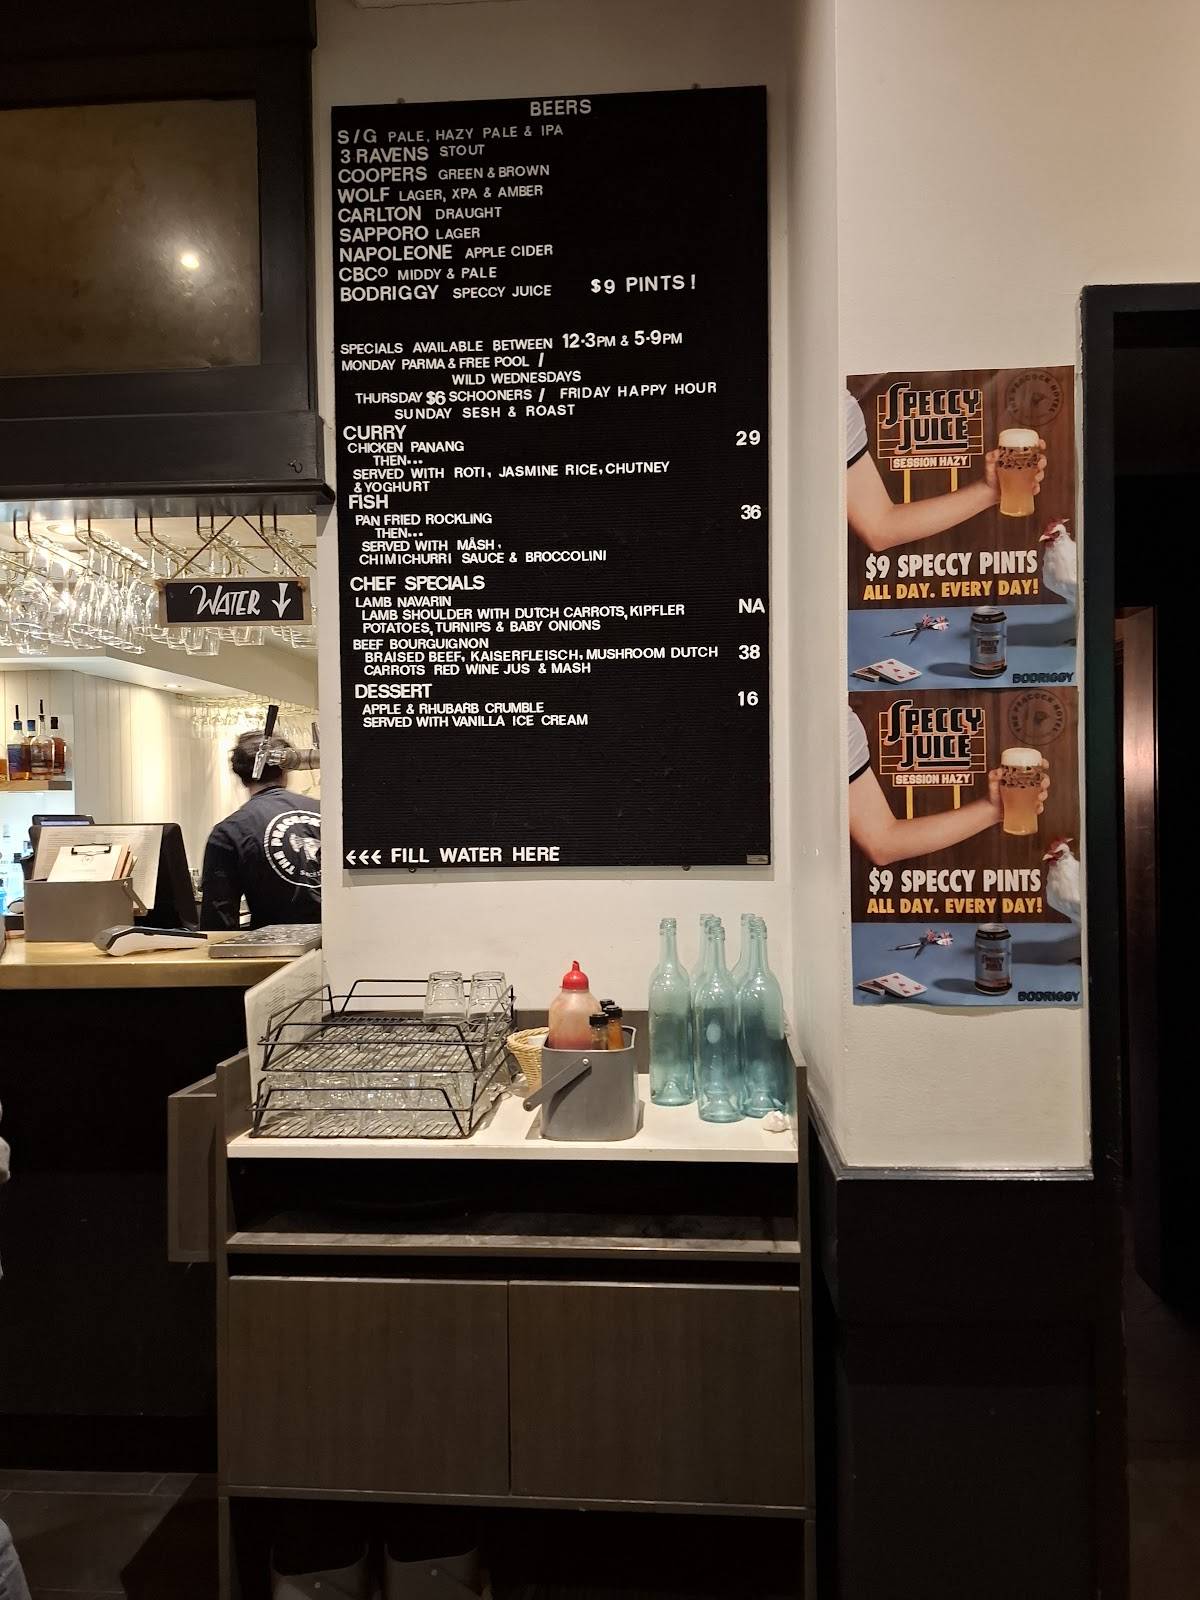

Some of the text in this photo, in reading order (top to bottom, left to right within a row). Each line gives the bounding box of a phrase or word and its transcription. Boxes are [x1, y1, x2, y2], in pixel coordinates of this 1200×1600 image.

[530, 99, 591, 116] BEERS
[436, 128, 473, 140] HAZY
[483, 126, 517, 138] PALE
[524, 126, 532, 136] &
[541, 124, 563, 136] IPA
[340, 144, 485, 164] 3 RAVENS STOUT
[338, 165, 549, 183] COOPERS GREEN & BROWN
[337, 185, 543, 203] WOLF LAGER, XPA & AMBER
[338, 206, 502, 223] CARLTON DRAUGHT
[340, 225, 480, 243] SAPPORO LAGER
[340, 244, 553, 262] NAPOLEONE APPLE CIDER
[398, 268, 442, 280] MIDDY
[446, 268, 455, 279] &
[461, 267, 497, 279] PALE
[340, 284, 552, 302] BODRIGGY SPECCY JUICE
[591, 279, 615, 294] $9
[340, 343, 403, 354] SPECIALS
[413, 340, 483, 353] AVAILABLE
[493, 338, 553, 352] BETWEEN
[620, 335, 629, 346] &
[342, 359, 396, 371] MONDAY
[402, 358, 446, 370] PARMA
[448, 358, 456, 369] &
[459, 357, 490, 369] FREE
[494, 356, 530, 367] POOL
[452, 370, 581, 385] WILD WEDNESDAYS
[355, 392, 423, 404] THURSDAY
[426, 391, 446, 405] $6
[449, 389, 532, 402] SCHOONERS
[560, 386, 611, 399] FRIDAY
[618, 384, 667, 397] HAPPY
[675, 382, 716, 395] HOUR
[394, 404, 575, 420] SUNDAY SESH & ROAST
[884, 382, 980, 428] SPECCY
[343, 425, 407, 440] CURRY
[736, 430, 760, 446] 29
[897, 416, 969, 452] JUICE
[347, 441, 464, 453] CHICKEN PANANG
[893, 456, 968, 468] SESSION HAZY
[353, 468, 404, 480] SERVED
[410, 467, 444, 479] WITH
[499, 465, 558, 478] JASMINE
[605, 461, 670, 474] CHUTNEY
[354, 481, 430, 493] & YOGHURT
[349, 494, 388, 509] FISH
[355, 513, 492, 526] PAN FRIED ROCKLING
[741, 504, 761, 520] 36
[361, 540, 410, 552] SERVED
[415, 540, 448, 551] WITH
[359, 550, 606, 565] CHIMICHURRI SAUCE & BROCCOLINI
[865, 550, 1038, 582] $9 SPECCY PINTS
[350, 575, 485, 591] CHEF SPECIALS
[863, 578, 1039, 600] ALL DAY. EVERY DAY!
[355, 596, 451, 608] LAMB NAVARIN
[739, 598, 765, 613] NA
[362, 604, 685, 621] LAMB SHOULDER WITH DUTCH CARROTS, KIPFLER
[363, 619, 601, 636] POTATOES, TURNIPS & BABY ONIONS
[353, 638, 489, 650] BEEF BOURGUIGNON
[739, 644, 760, 660] 38
[365, 651, 424, 663] BRAISED
[586, 647, 665, 660] MUSHROOM
[671, 646, 718, 658] DUTCH
[364, 662, 591, 676] CARROTS RED WINE JUS & MASH
[355, 683, 433, 699] DESSERT
[738, 691, 758, 706] 16
[362, 702, 544, 715] APPLE & RHUBARB CRUMBLE
[363, 714, 588, 728] SERVED WITH VANILLA ICE CREAM
[883, 699, 983, 745] SPECCY
[898, 734, 971, 770] JUICE
[895, 773, 971, 785] SESSION HAZY
[391, 846, 560, 863] FILL WATER HERE
[868, 867, 1042, 895] $9 SPECCY PINTS
[867, 896, 1043, 914] ALL DAY. EVERY DAY!
